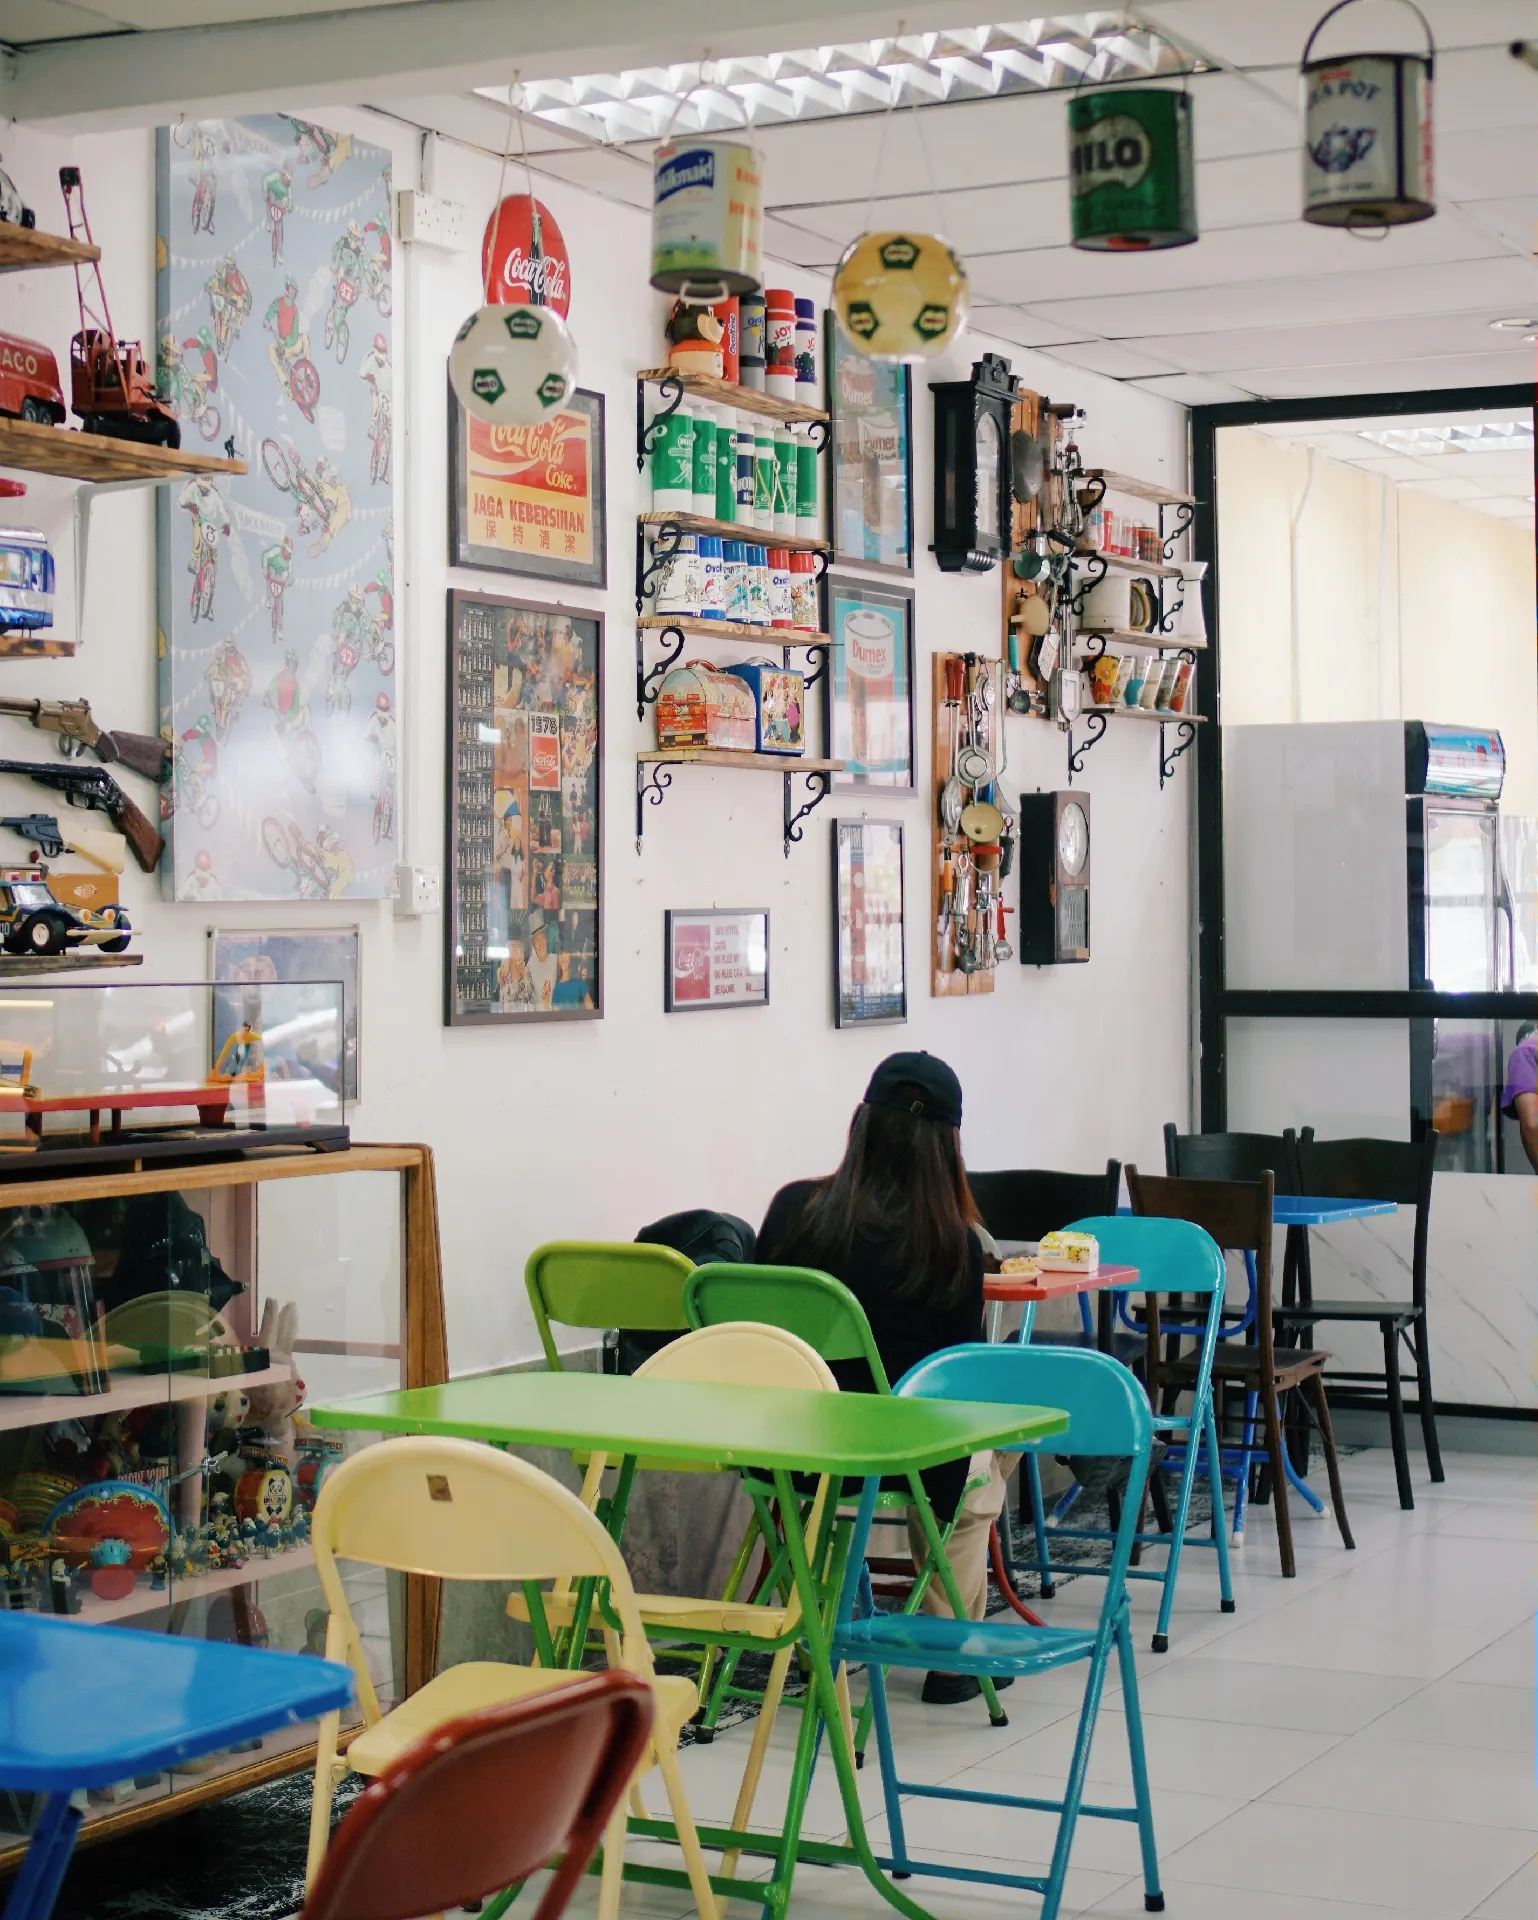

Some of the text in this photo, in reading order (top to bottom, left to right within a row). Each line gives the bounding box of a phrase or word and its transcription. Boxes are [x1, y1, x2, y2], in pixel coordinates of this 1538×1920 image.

[503, 248, 566, 300] Coca-Cola
[774, 325, 791, 340] JOY
[842, 378, 873, 405] Dumex
[545, 464, 574, 490] Coke
[473, 492, 585, 533] JAGA KEBERSIHAN
[852, 639, 886, 662] Dumex
[530, 715, 558, 735] 1978
